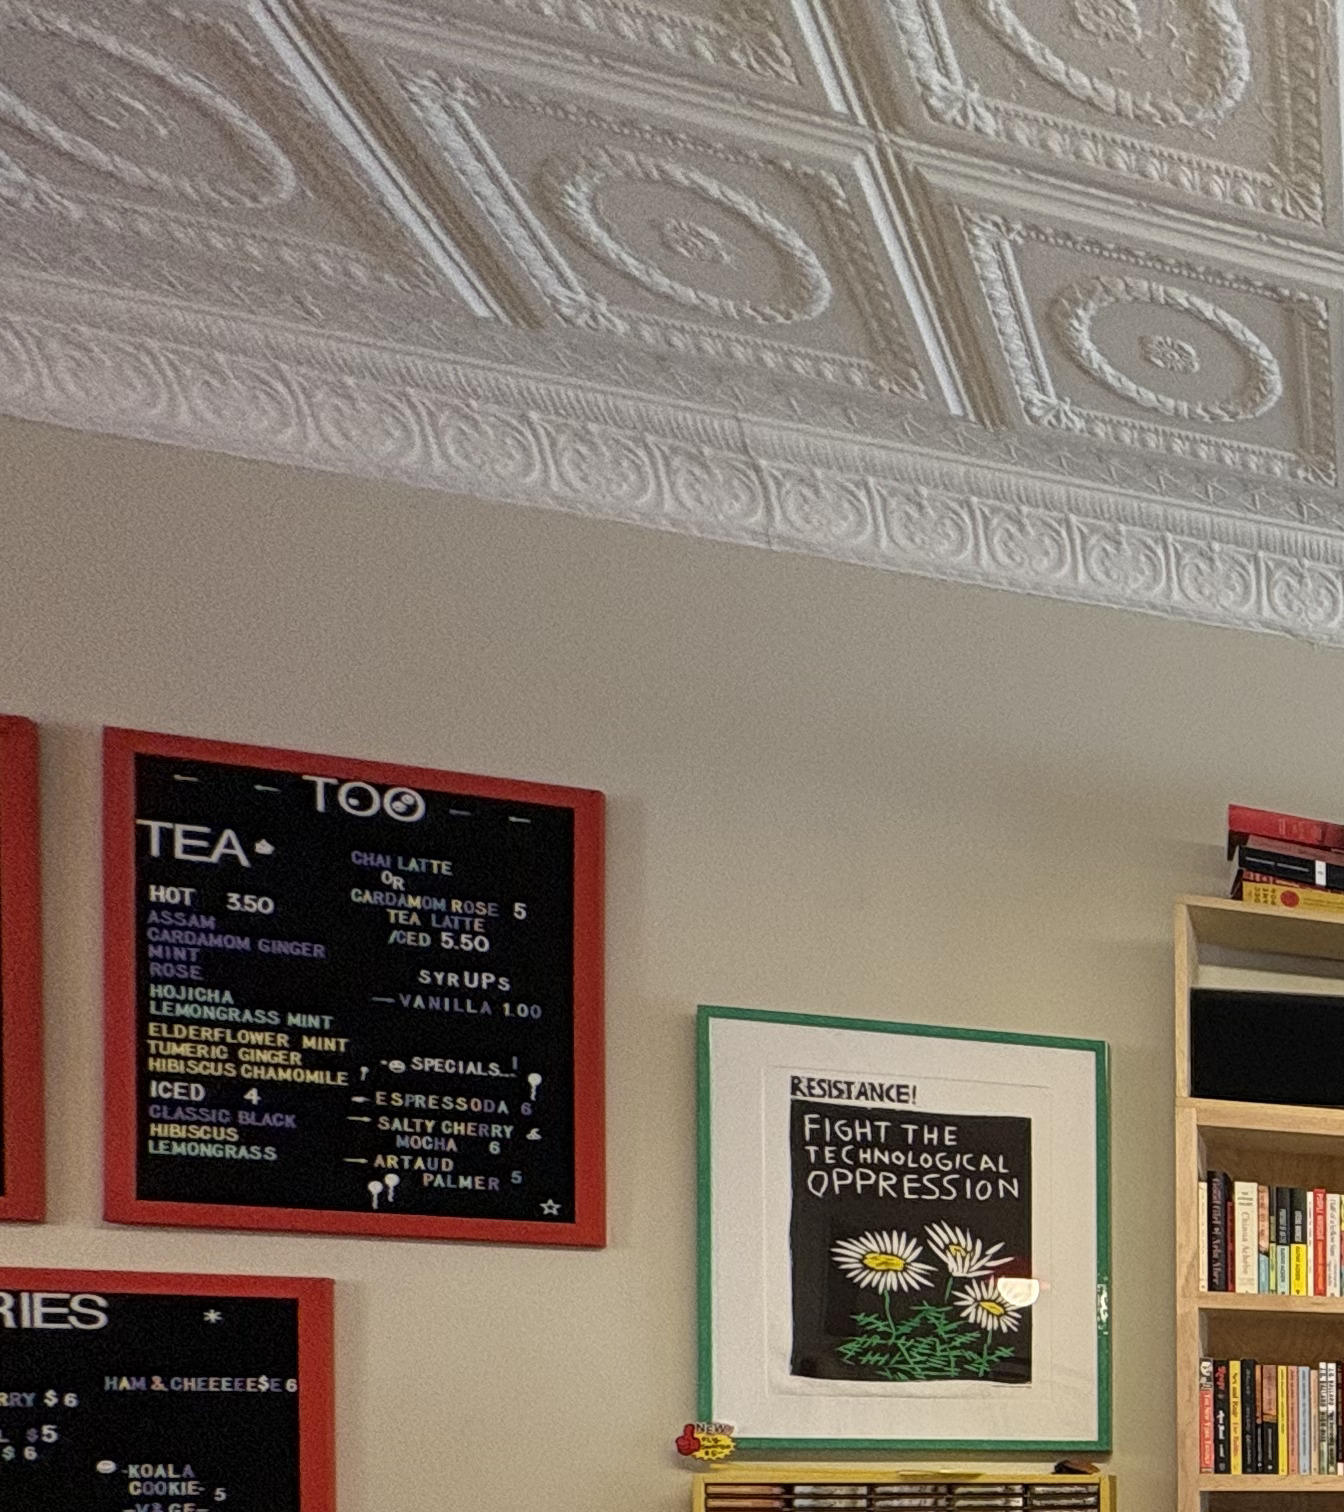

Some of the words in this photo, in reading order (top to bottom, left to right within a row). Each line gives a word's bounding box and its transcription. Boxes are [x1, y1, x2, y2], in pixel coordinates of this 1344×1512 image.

[136, 819, 250, 868] TEA
[351, 850, 392, 869] CHAI
[398, 858, 453, 876] LATTE
[381, 870, 405, 891] OR
[150, 884, 196, 906] HOT
[350, 888, 447, 912] CARDAMOM
[451, 899, 499, 917] ROSE
[513, 903, 528, 920] 5
[147, 910, 216, 929] ASSAM
[387, 909, 422, 926] TEA
[431, 913, 486, 933] LATTE
[147, 927, 250, 949] CARDAMOM
[257, 938, 326, 958] GINGER
[149, 944, 202, 961] MINT
[388, 930, 432, 946] ICED
[440, 932, 490, 953] 5.50
[150, 962, 203, 980] ROSE
[418, 970, 511, 991] SYRUPS
[150, 984, 234, 1004] HOJICHA
[399, 994, 492, 1015] VANILLA
[150, 1001, 281, 1025] LEMONGRASS
[287, 1012, 334, 1030] MINT
[148, 1022, 290, 1048] ELDERFLOWER
[302, 1035, 349, 1053] MINT
[147, 1040, 229, 1060] TUMERIC
[238, 1048, 302, 1066] GINGER
[148, 1057, 237, 1077] HIBISCUS
[240, 1063, 349, 1086] CHAMOMILE
[151, 1080, 206, 1101] ICED
[243, 1087, 262, 1106] 4
[791, 1075, 917, 1105] RESISTANCE!
[375, 1091, 509, 1115] ESPRESSODA
[520, 1102, 533, 1116] 6
[150, 1104, 232, 1123] CLASSIC
[238, 1110, 297, 1128] BLACK
[377, 1116, 436, 1133] SALTY
[441, 1120, 514, 1139] CHERRY
[150, 1123, 240, 1142] HIBISCUS
[804, 1113, 892, 1143] FIGHT
[901, 1123, 958, 1146] THE
[148, 1140, 278, 1161] LEMONGRASS
[396, 1135, 458, 1151] MOCHA
[489, 1141, 501, 1155] 6
[373, 1154, 455, 1172] ARTAUD
[804, 1145, 1010, 1173] TECHNOLOGICAL
[423, 1173, 500, 1191] PALMER
[511, 1170, 523, 1184] 5
[807, 1167, 1019, 1200] OPPRESSION
[104, 1376, 147, 1391] HAM
[151, 1375, 168, 1391] &
[285, 1378, 298, 1392] 6
[214, 1487, 227, 1502] 5
